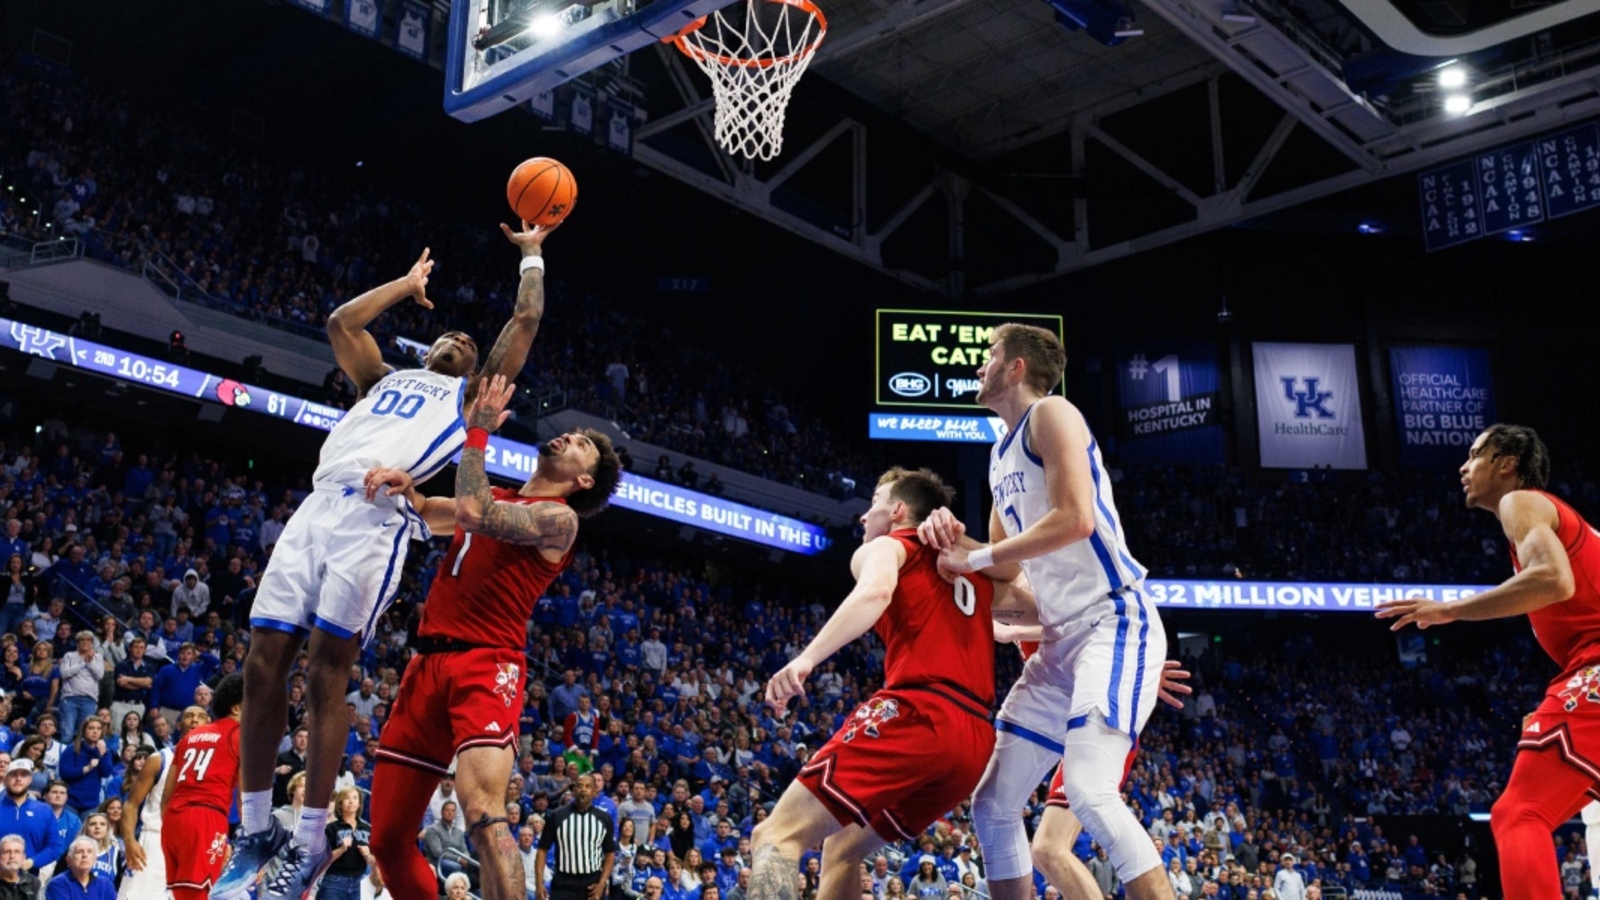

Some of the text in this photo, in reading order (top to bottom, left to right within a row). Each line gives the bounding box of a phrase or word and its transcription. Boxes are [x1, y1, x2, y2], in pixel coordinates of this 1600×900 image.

[1542, 140, 1565, 198] NCAA
[1481, 155, 1501, 213] NCAA
[1422, 176, 1441, 232] NCAA
[1460, 179, 1478, 235] 1942
[892, 323, 941, 342] EAT
[94, 350, 179, 388] 2ND 10:54
[1129, 354, 1180, 402] #1
[1399, 373, 1461, 386] OFFICIAL
[895, 378, 924, 391] BHG
[1280, 376, 1334, 418] UK
[1400, 386, 1488, 400] HEALTHCARE
[267, 393, 286, 416] 61
[371, 389, 426, 419] 00
[1128, 397, 1211, 422] HOSPITAL IN
[1402, 400, 1485, 413] PARTNER OF
[1134, 411, 1207, 435] KENTUCKY
[1275, 422, 1348, 436] HealthCare
[1404, 414, 1485, 429] BIG BLUE
[936, 430, 962, 440] WITH
[1405, 430, 1477, 446] NATION
[616, 481, 697, 517] EHICLES
[701, 503, 753, 531] BUILT
[755, 518, 775, 538] IN
[778, 523, 811, 547] THE
[451, 531, 472, 577] 1
[953, 575, 976, 617] 0
[1150, 583, 1187, 604] 32
[1194, 584, 1325, 606] MILLION
[177, 747, 215, 782] 24
